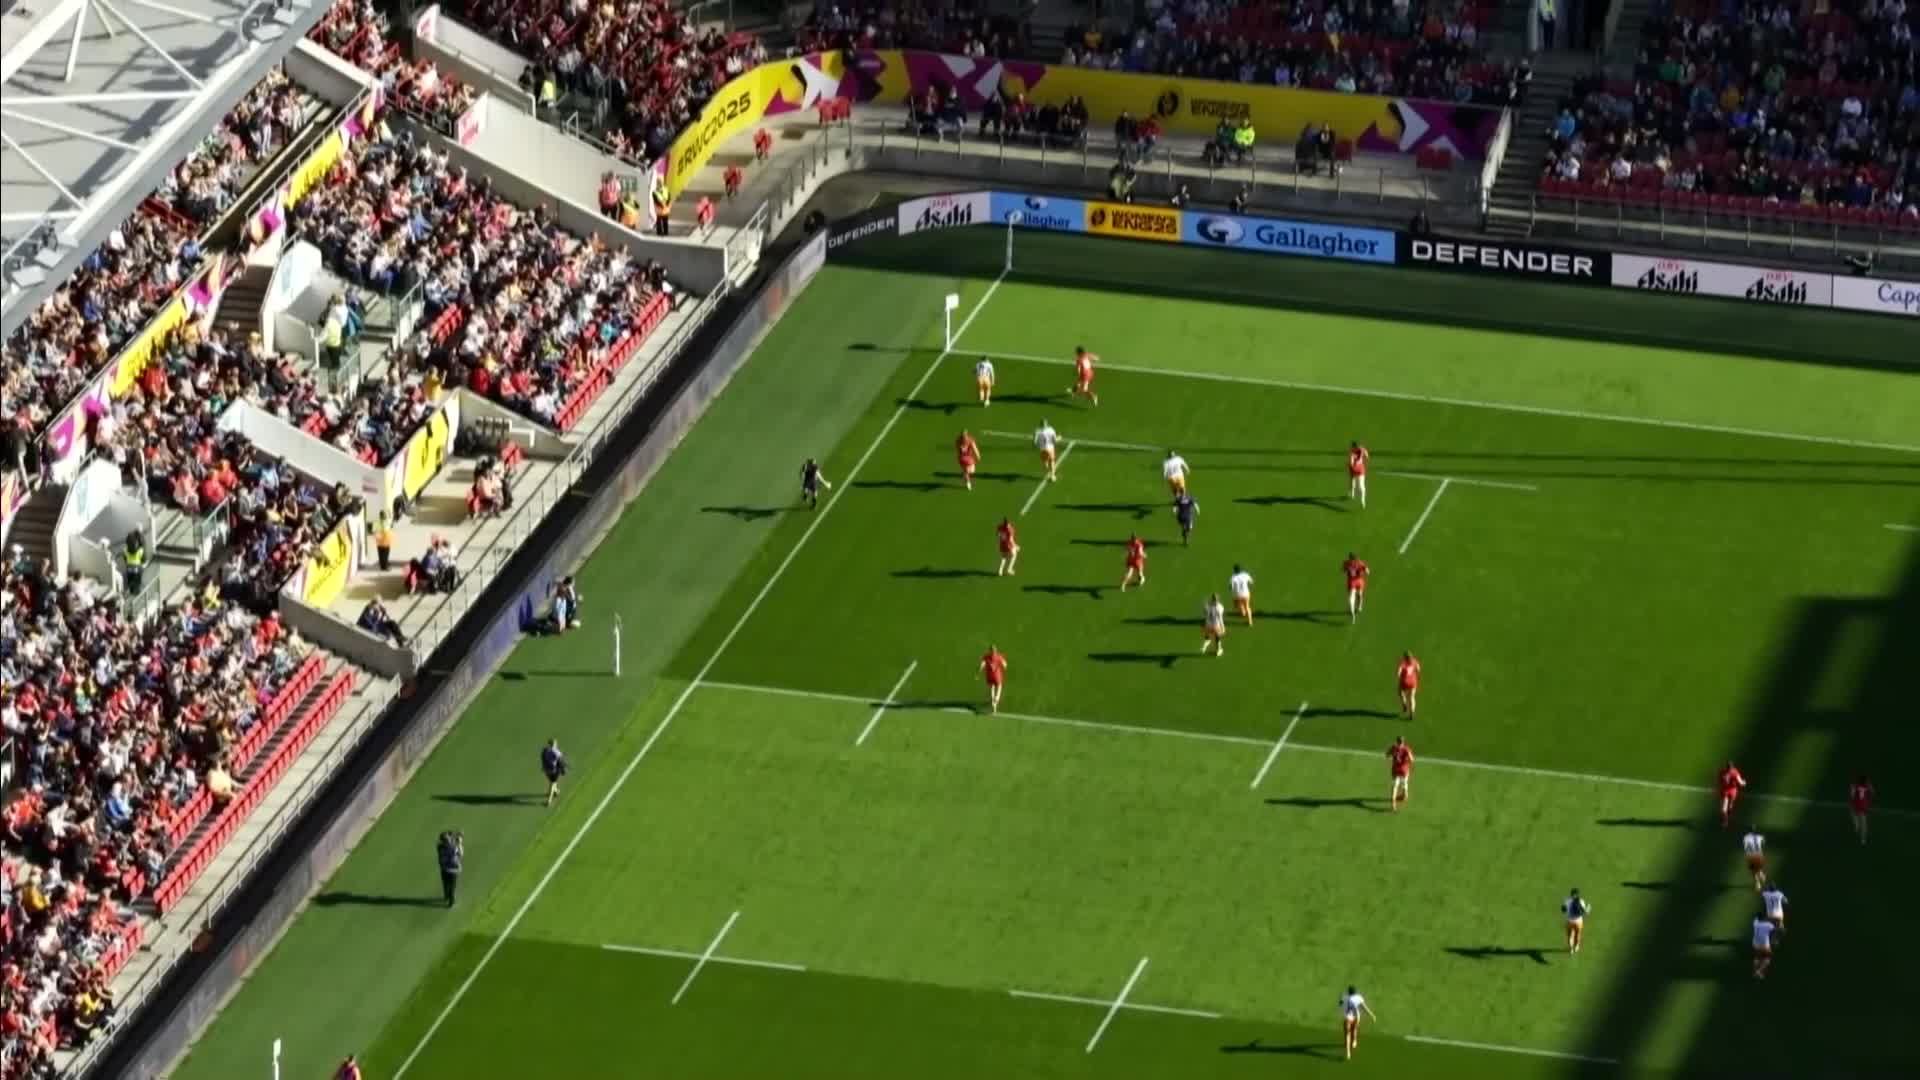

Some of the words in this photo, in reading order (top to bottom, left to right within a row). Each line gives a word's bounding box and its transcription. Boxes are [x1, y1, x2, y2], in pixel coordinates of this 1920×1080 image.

[677, 91, 751, 176] #RWC2025
[916, 202, 972, 231] Asahi
[1004, 211, 1071, 230] Gllagher
[828, 216, 895, 249] DEFENDER
[1256, 225, 1379, 256] Gallagher
[1412, 239, 1593, 277] DEFENDER
[1637, 266, 1698, 291] Asahi
[1745, 277, 1807, 304] Asahi
